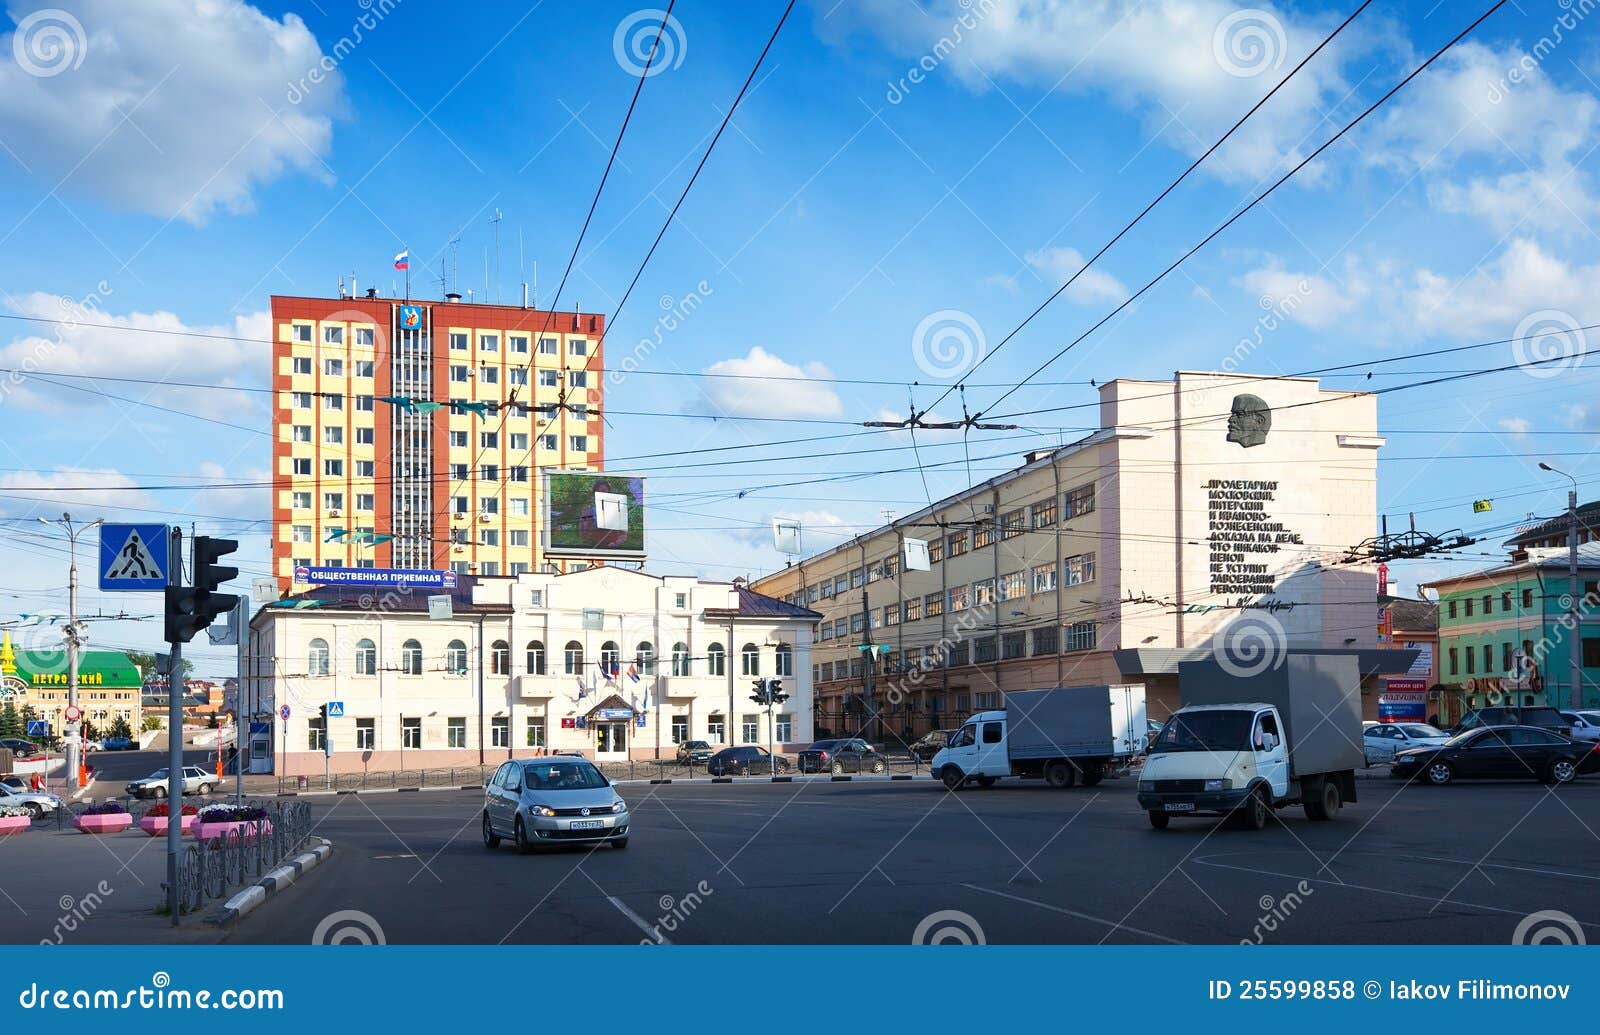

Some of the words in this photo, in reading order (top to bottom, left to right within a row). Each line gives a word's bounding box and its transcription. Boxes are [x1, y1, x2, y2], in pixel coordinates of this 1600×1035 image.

[1209, 563, 1224, 572] НЕ
[1226, 563, 1268, 574] УСТУПИТ
[311, 571, 388, 582] ОБЩЕСТВЕННАЯ
[390, 573, 441, 583] ПРИЕМНАЯ
